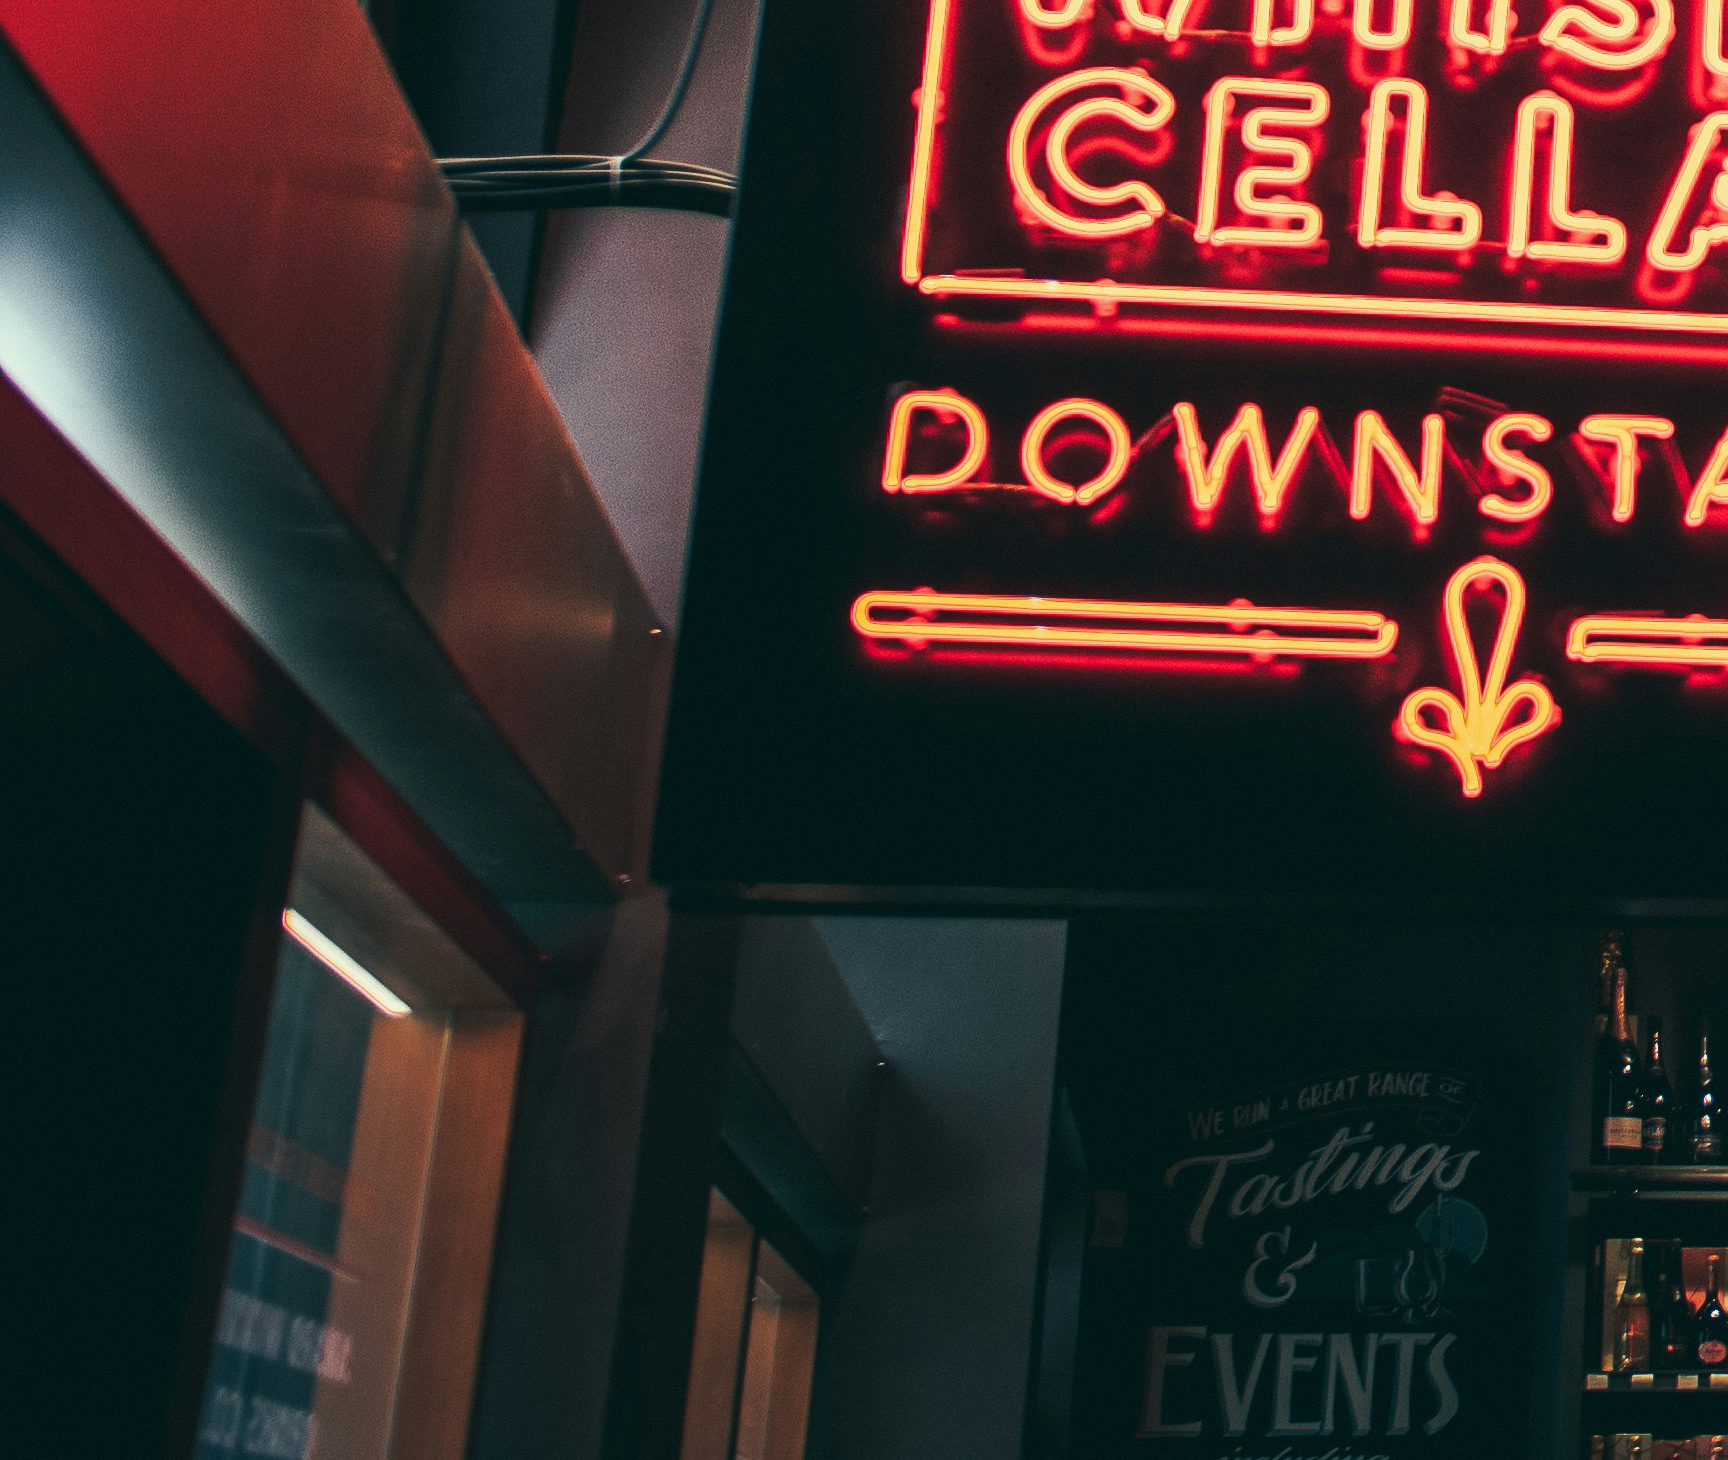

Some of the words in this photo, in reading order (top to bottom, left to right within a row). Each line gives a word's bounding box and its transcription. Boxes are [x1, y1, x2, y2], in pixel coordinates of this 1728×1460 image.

[1187, 1106, 1225, 1141] WE
[1232, 1096, 1271, 1128] RUN
[1296, 1074, 1361, 1111] GREAT
[1367, 1071, 1433, 1098] RANGE
[1162, 1121, 1481, 1250] Tastings
[1241, 1224, 1318, 1308] &
[1138, 1325, 1460, 1438] EVENTS
